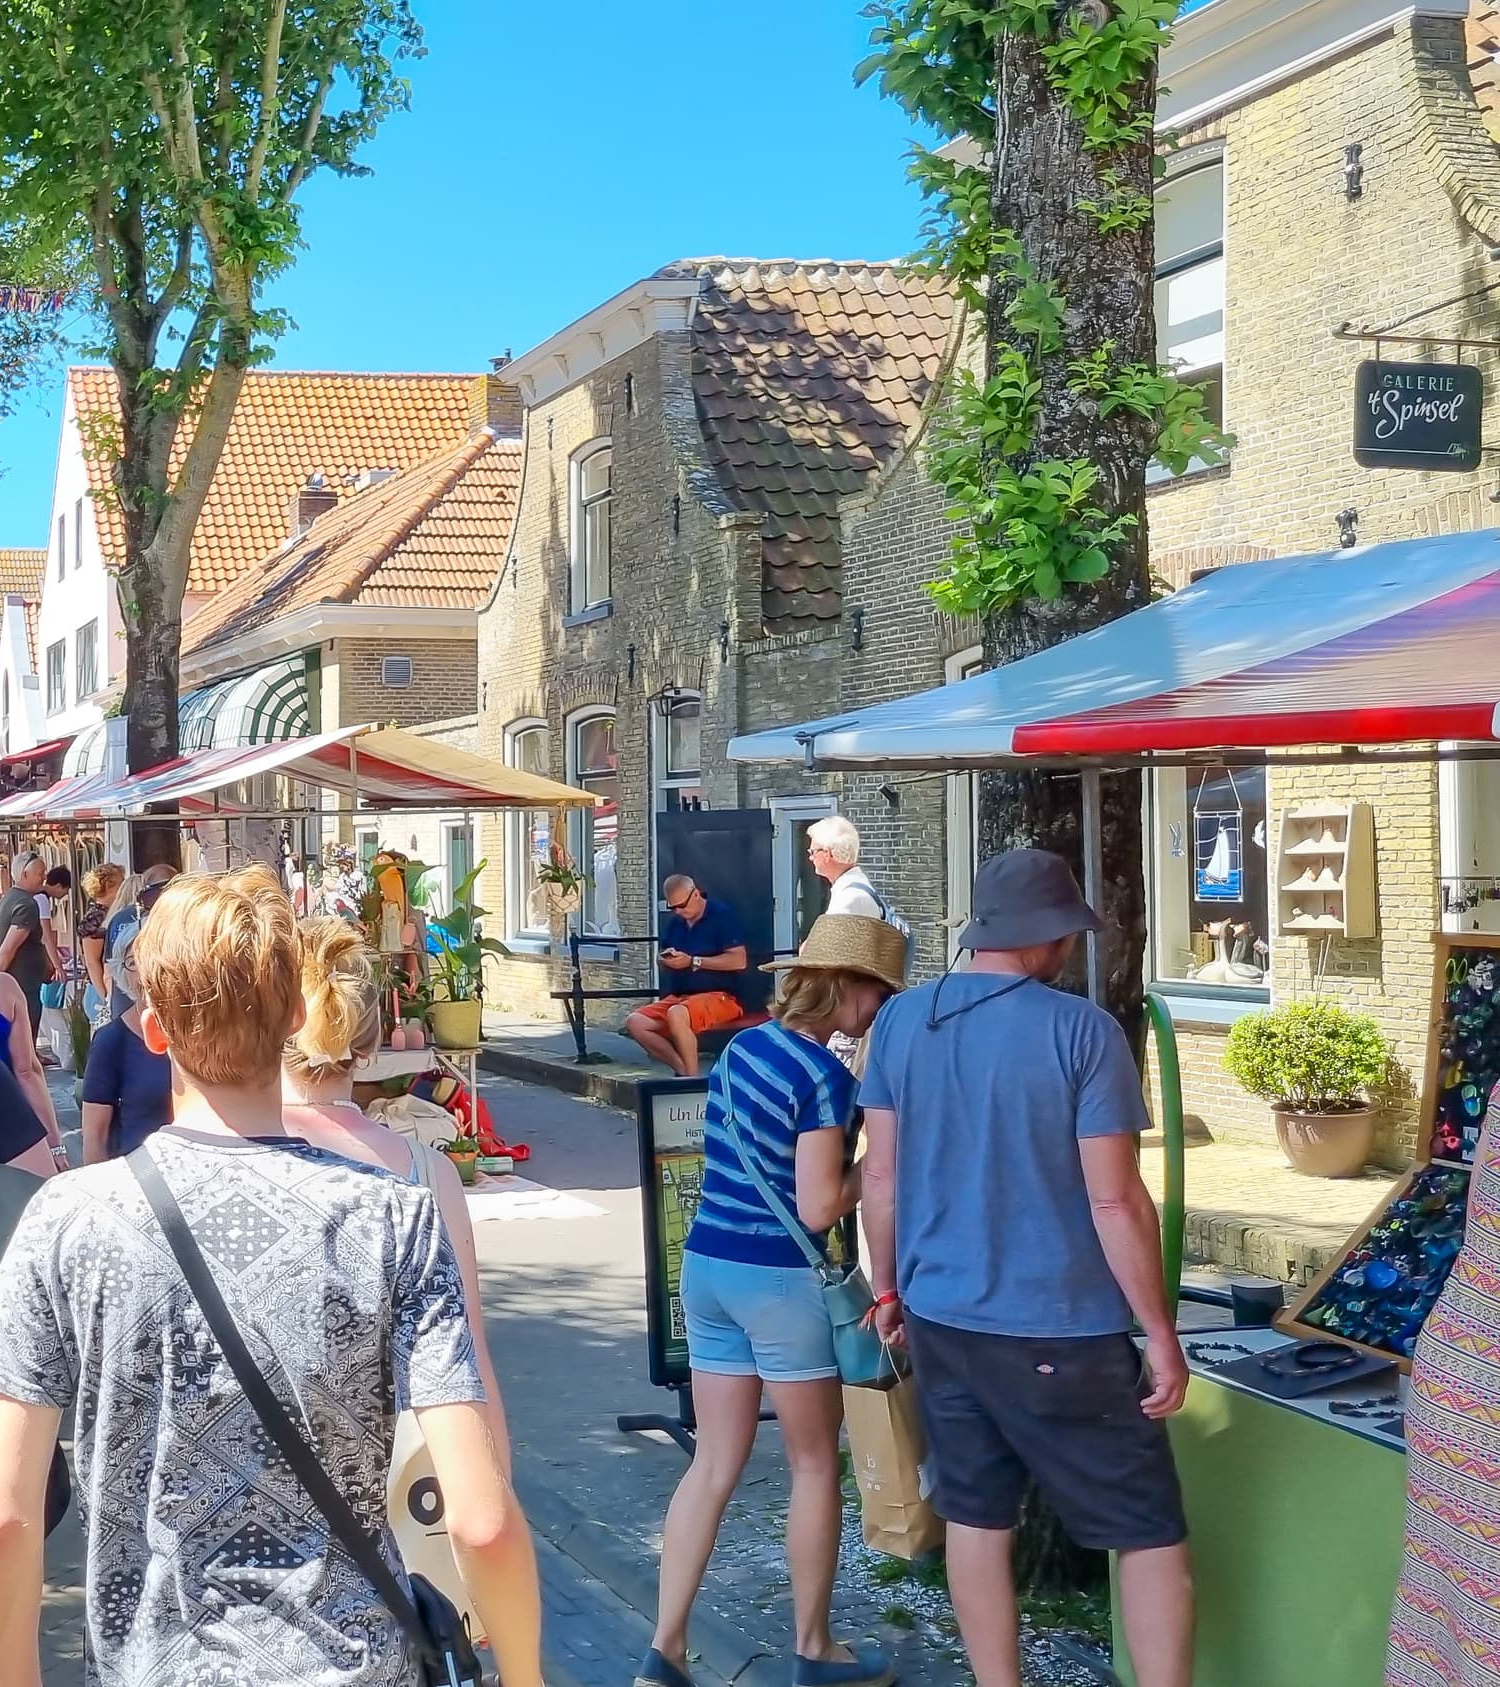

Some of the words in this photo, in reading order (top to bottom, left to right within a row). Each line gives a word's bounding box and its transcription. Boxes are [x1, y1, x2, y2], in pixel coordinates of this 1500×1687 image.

[1383, 374, 1455, 392] GALERIE
[1375, 389, 1465, 439] Spinsel
[669, 1107, 691, 1121] Un
